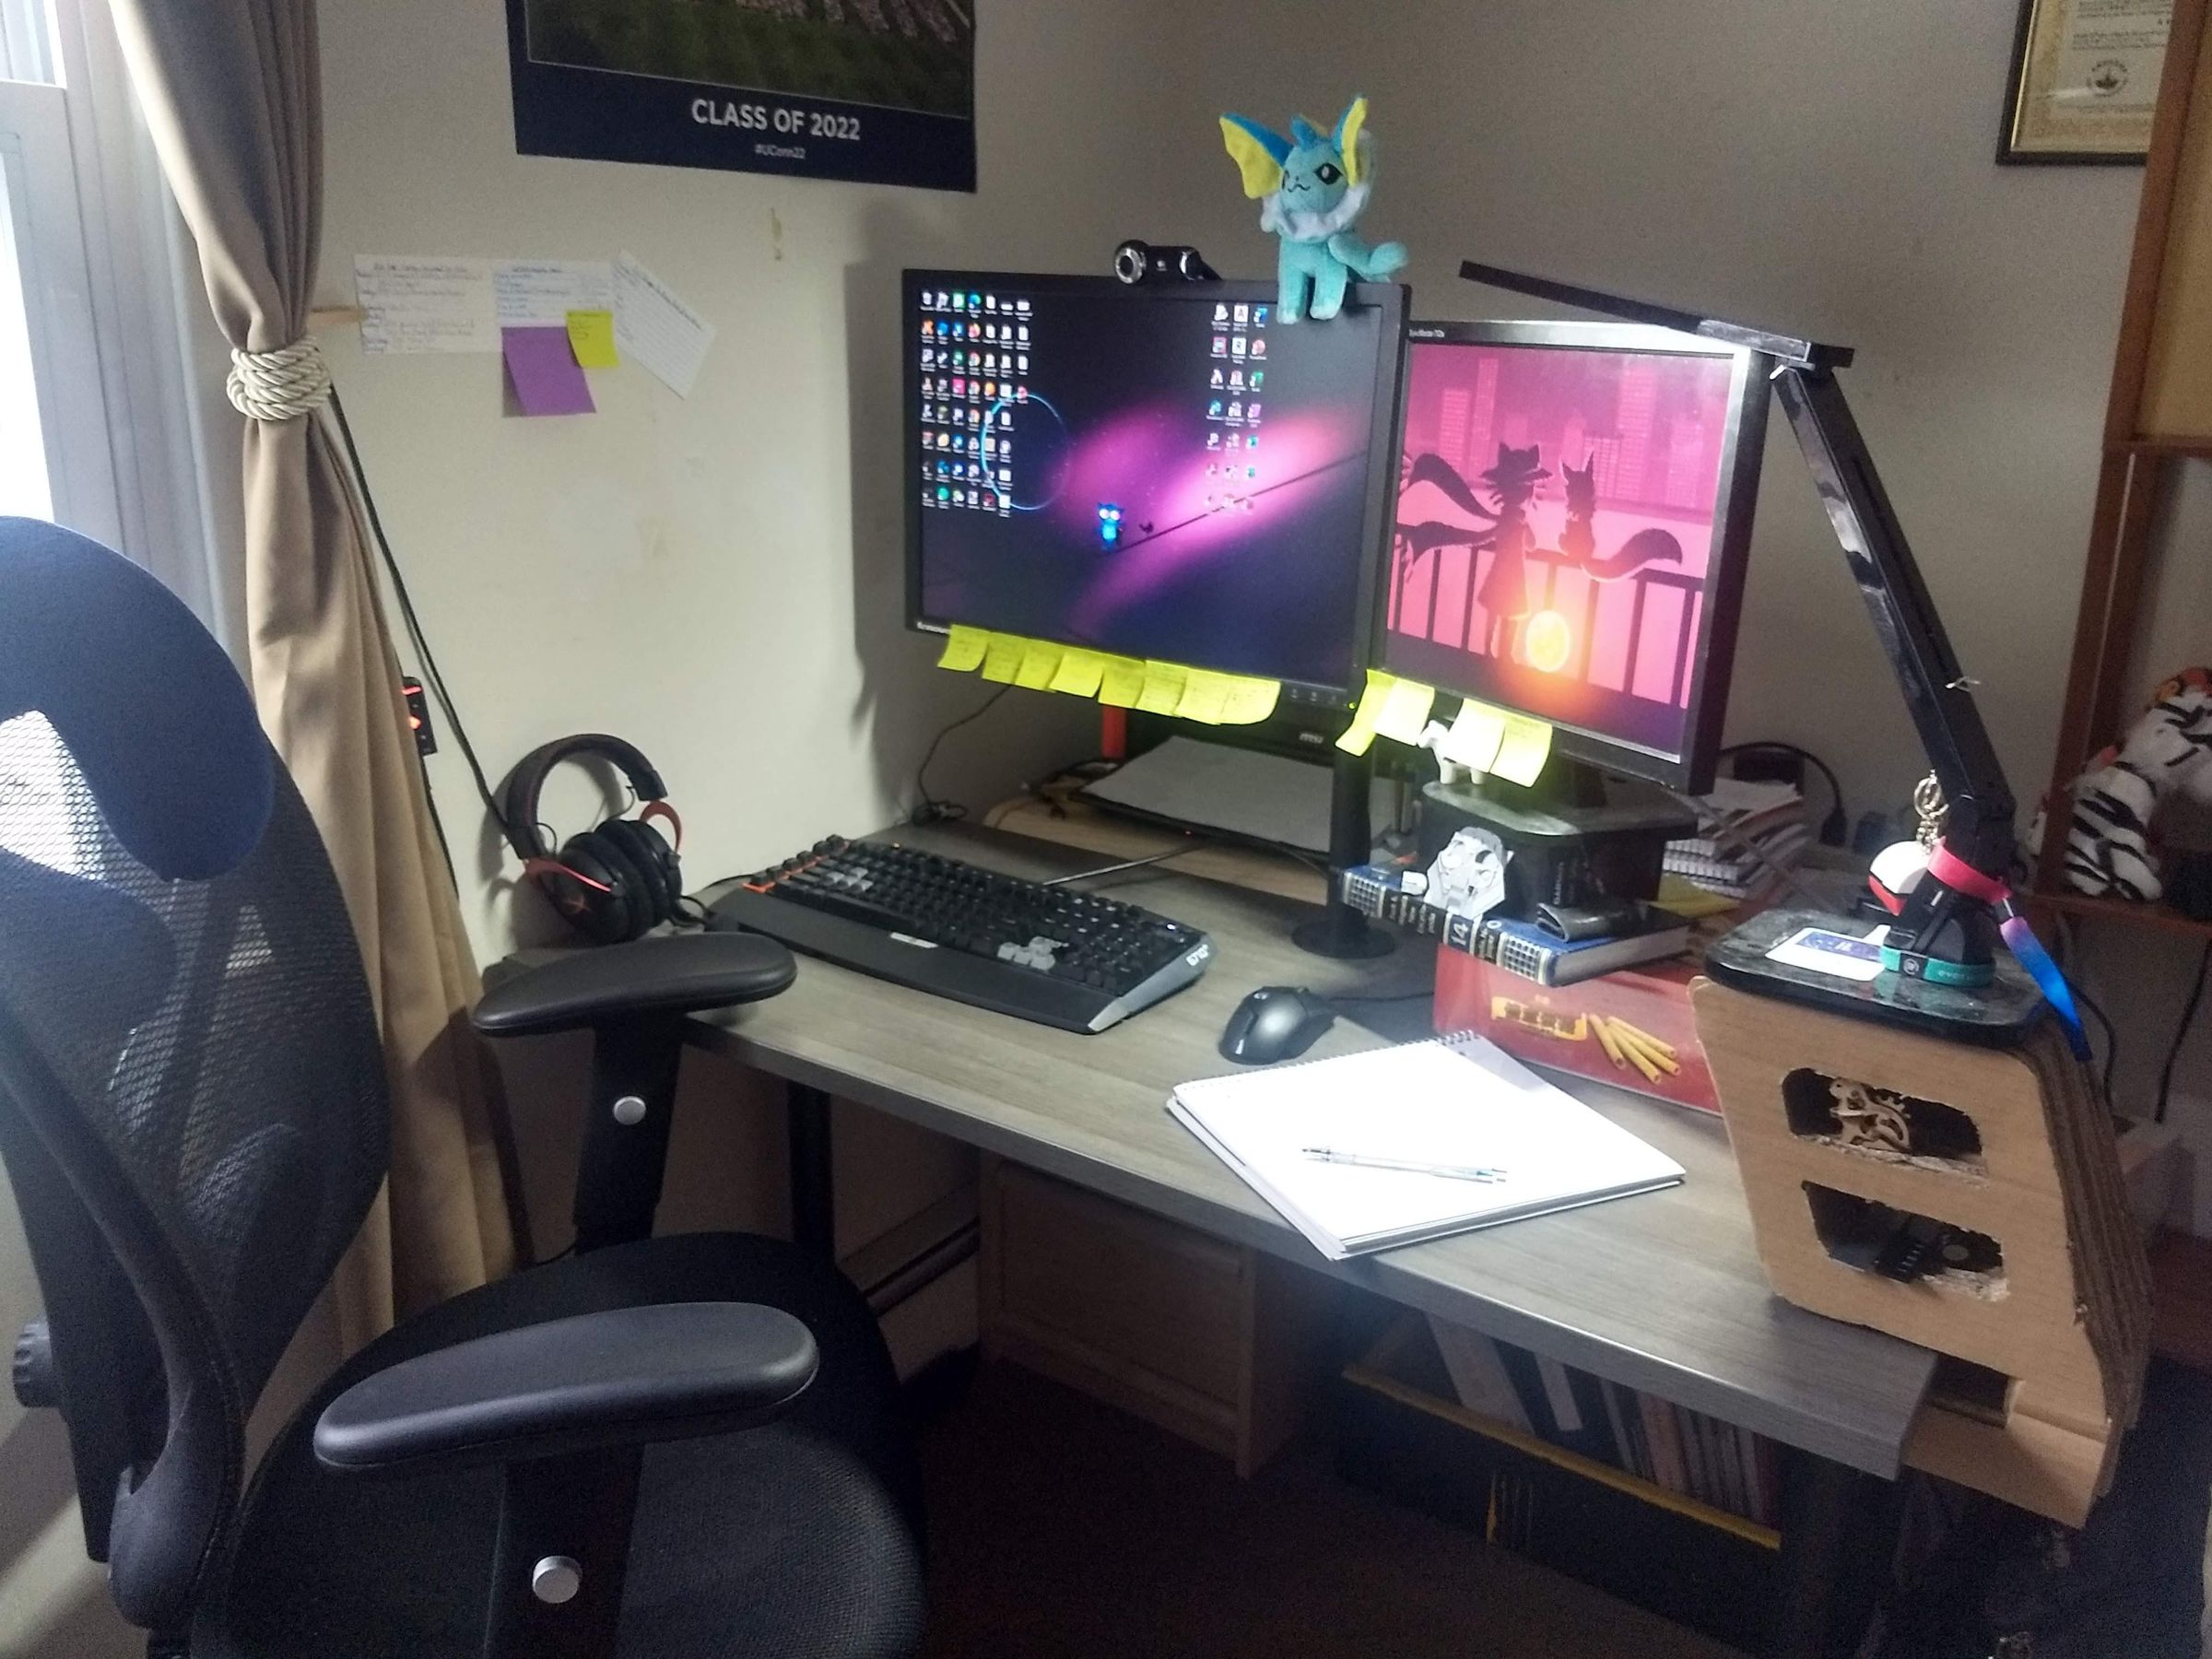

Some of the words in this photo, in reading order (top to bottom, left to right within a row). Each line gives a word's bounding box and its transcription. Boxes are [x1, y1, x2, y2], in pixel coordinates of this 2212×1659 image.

[691, 98, 768, 131] CLASS
[773, 108, 805, 135] OF
[809, 112, 861, 141] 2022
[1451, 923, 1468, 946] 14
